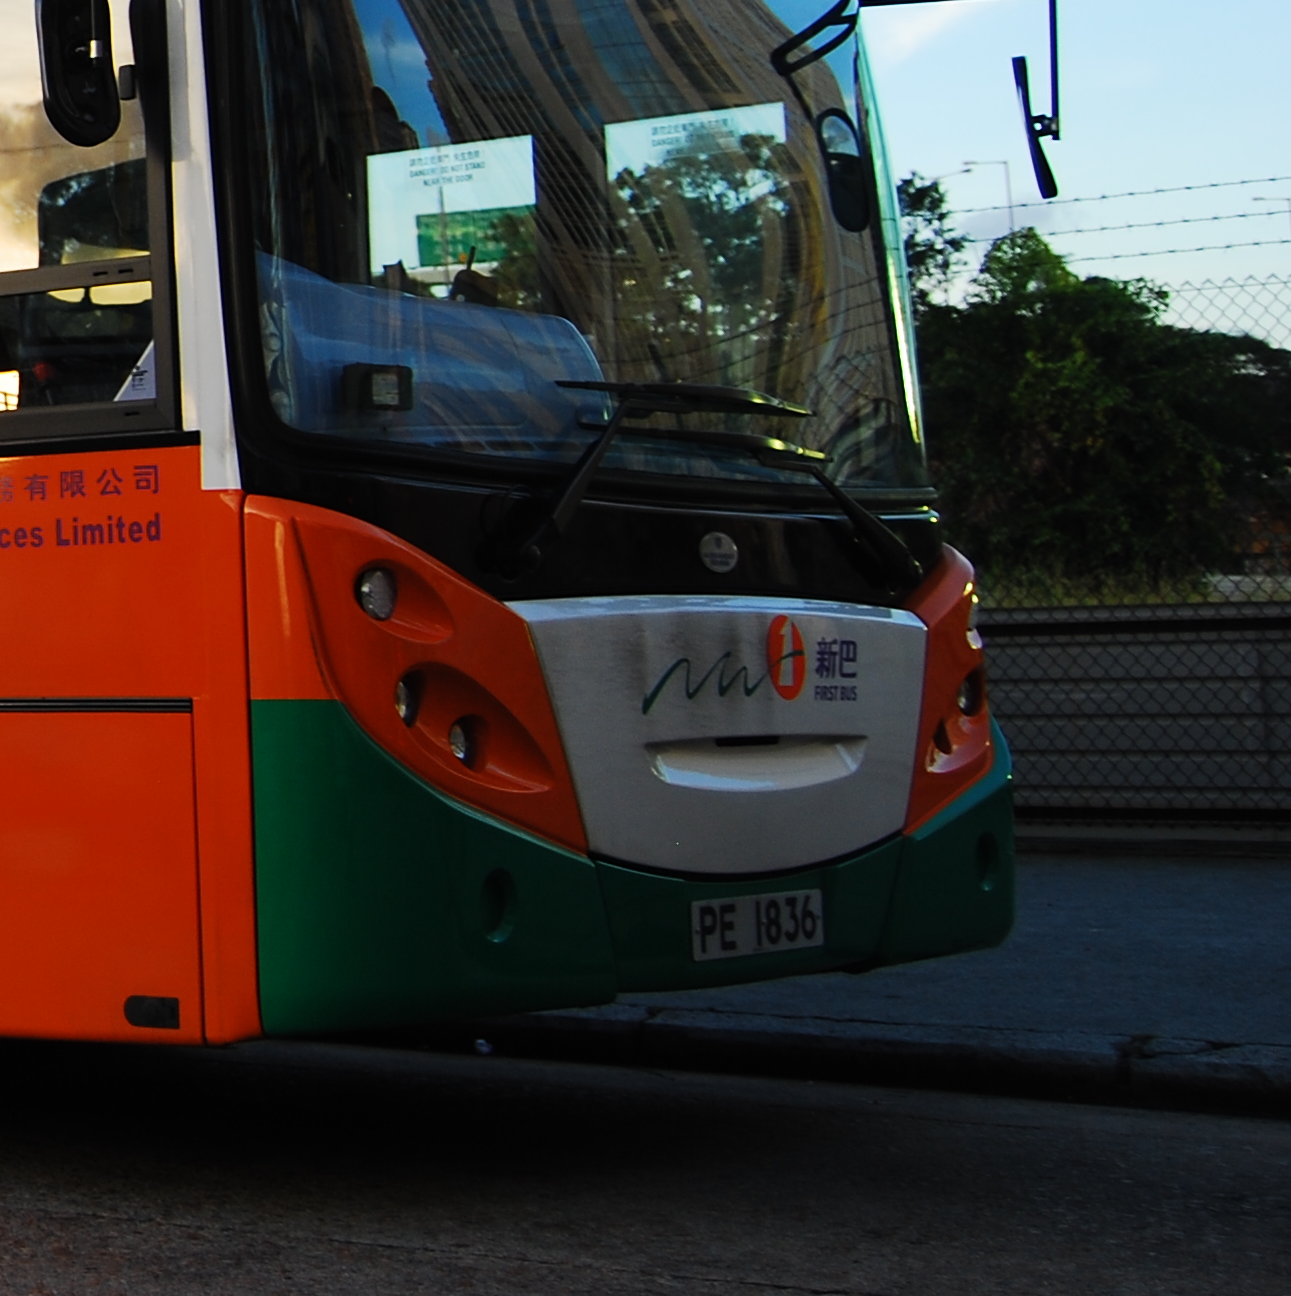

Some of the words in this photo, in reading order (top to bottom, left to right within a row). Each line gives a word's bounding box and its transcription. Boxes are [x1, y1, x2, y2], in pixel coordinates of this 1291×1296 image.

[55, 512, 162, 548] Limited
[815, 636, 858, 679] 新巴
[814, 685, 838, 701] FIRST
[840, 685, 857, 701] BUS
[699, 904, 737, 954] PE
[755, 894, 816, 946] 1836
